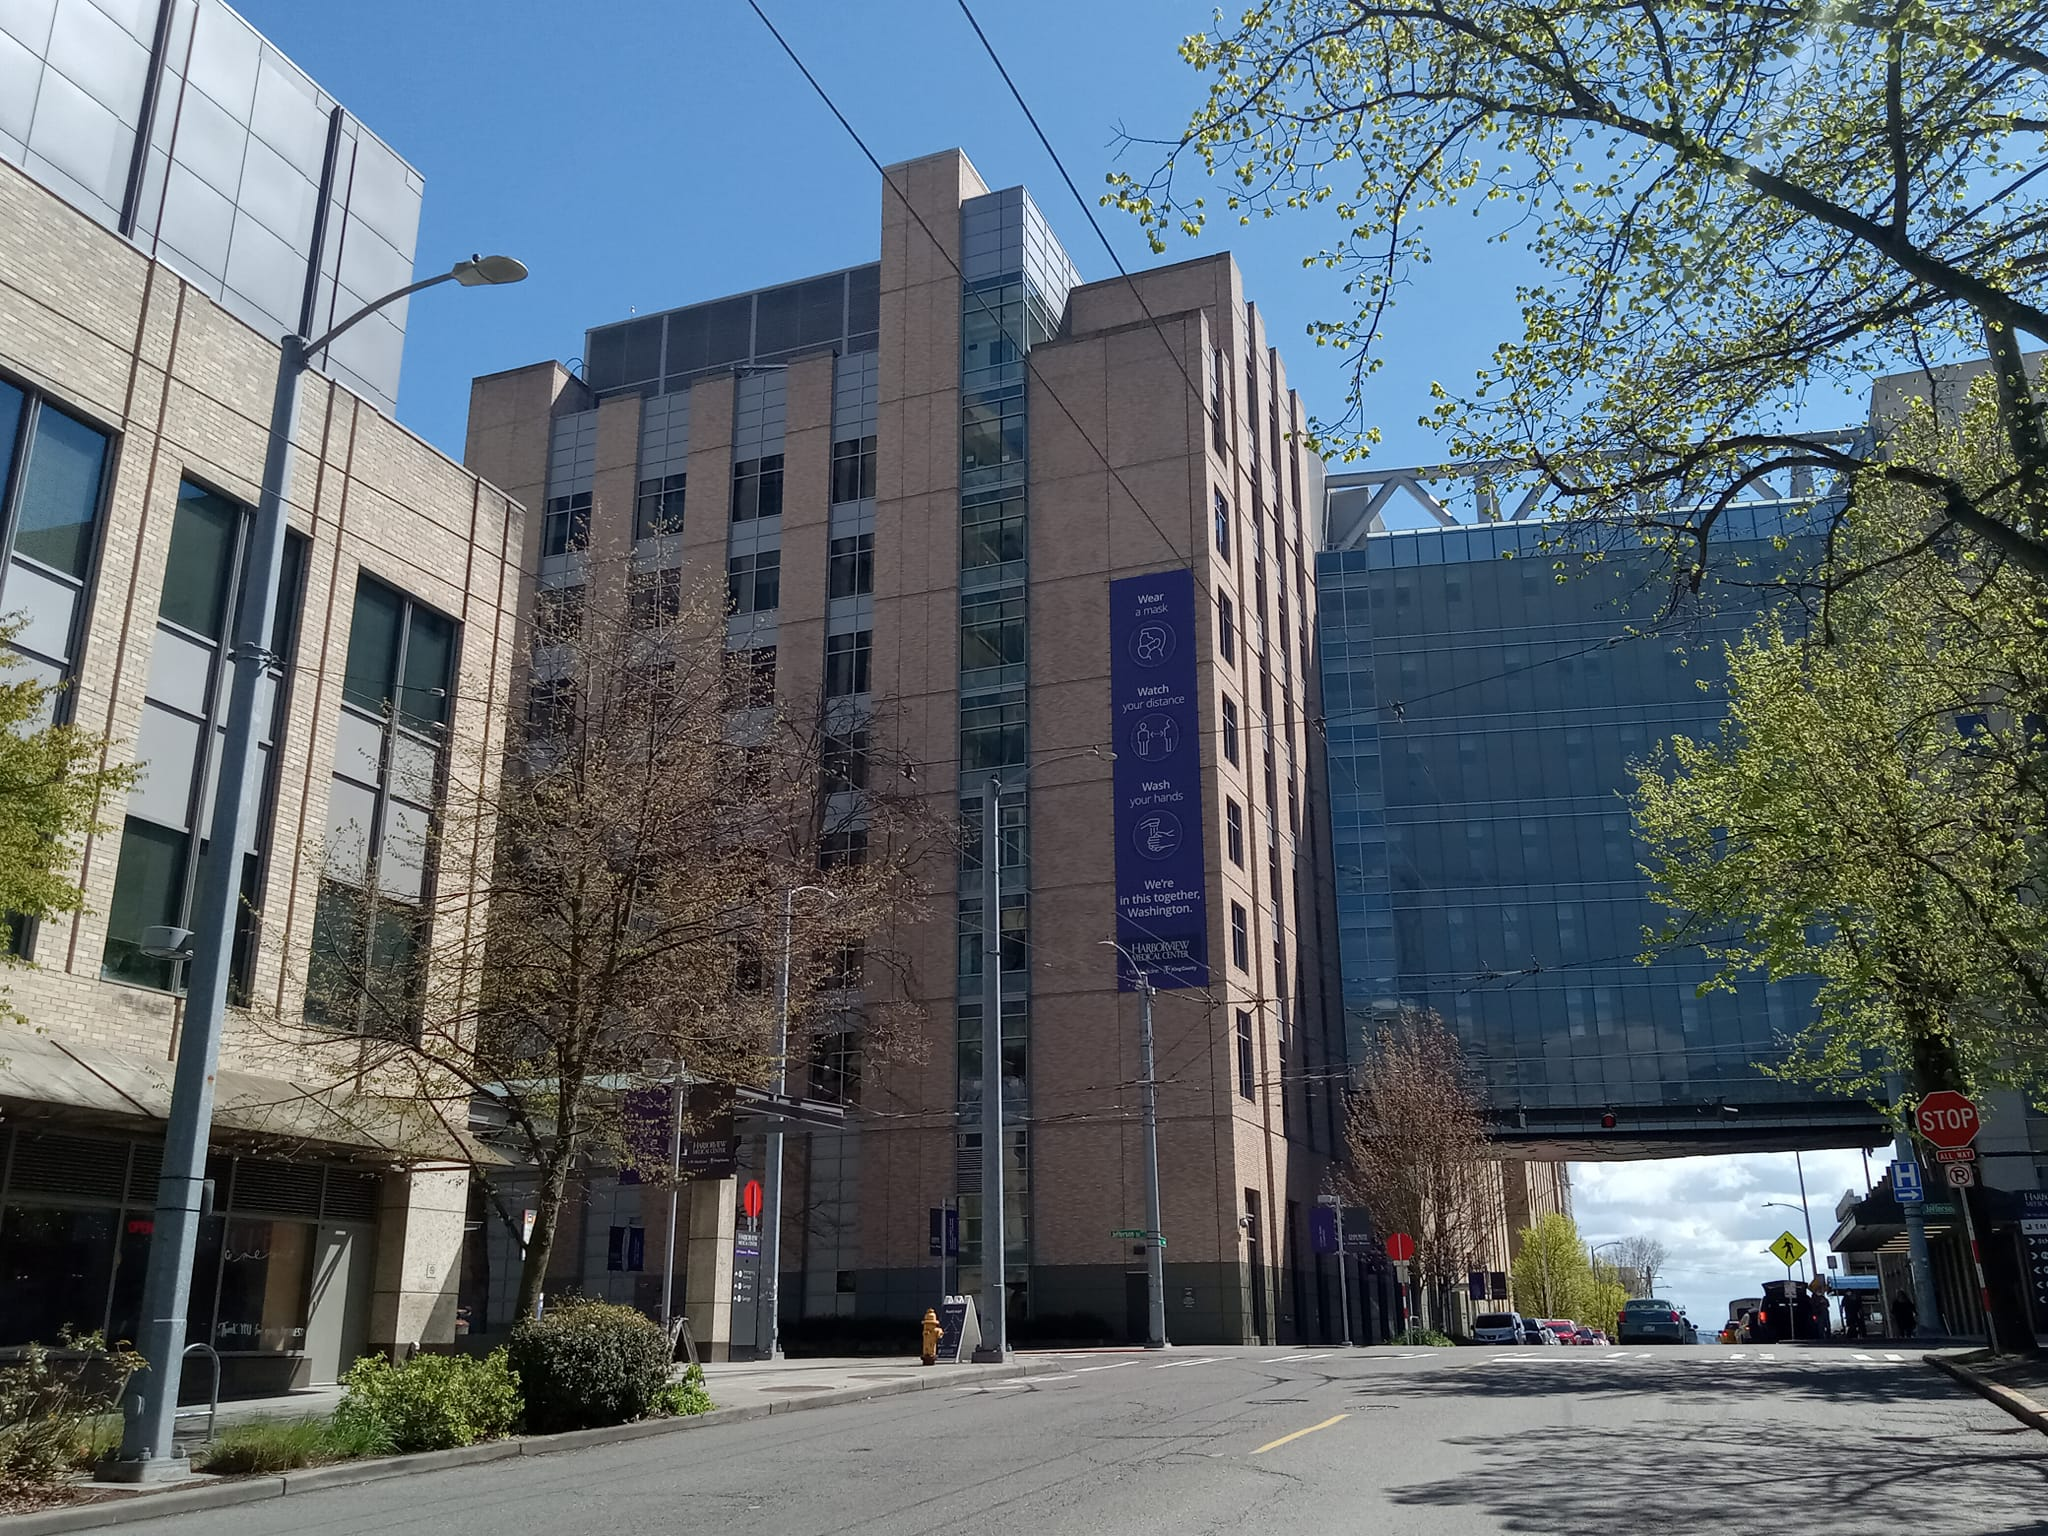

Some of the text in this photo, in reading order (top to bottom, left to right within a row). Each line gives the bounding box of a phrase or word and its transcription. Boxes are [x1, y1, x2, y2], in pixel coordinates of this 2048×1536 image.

[1137, 593, 1165, 604] Wear
[1135, 603, 1169, 617] a mask
[1137, 683, 1169, 697] Watch
[1122, 695, 1185, 714] your distance
[1142, 780, 1170, 792] Wash
[1129, 792, 1184, 808] your hands
[1144, 879, 1174, 890] We're
[1120, 890, 1201, 906] in this together,
[1127, 905, 1193, 918] Washington.
[1132, 940, 1190, 954] HARBORVIEW
[1132, 950, 1189, 961] MEDICAL CENTER
[1921, 1107, 1974, 1132] STOP
[1940, 1151, 1971, 1161] ALL WAY
[1895, 1163, 1917, 1187] H
